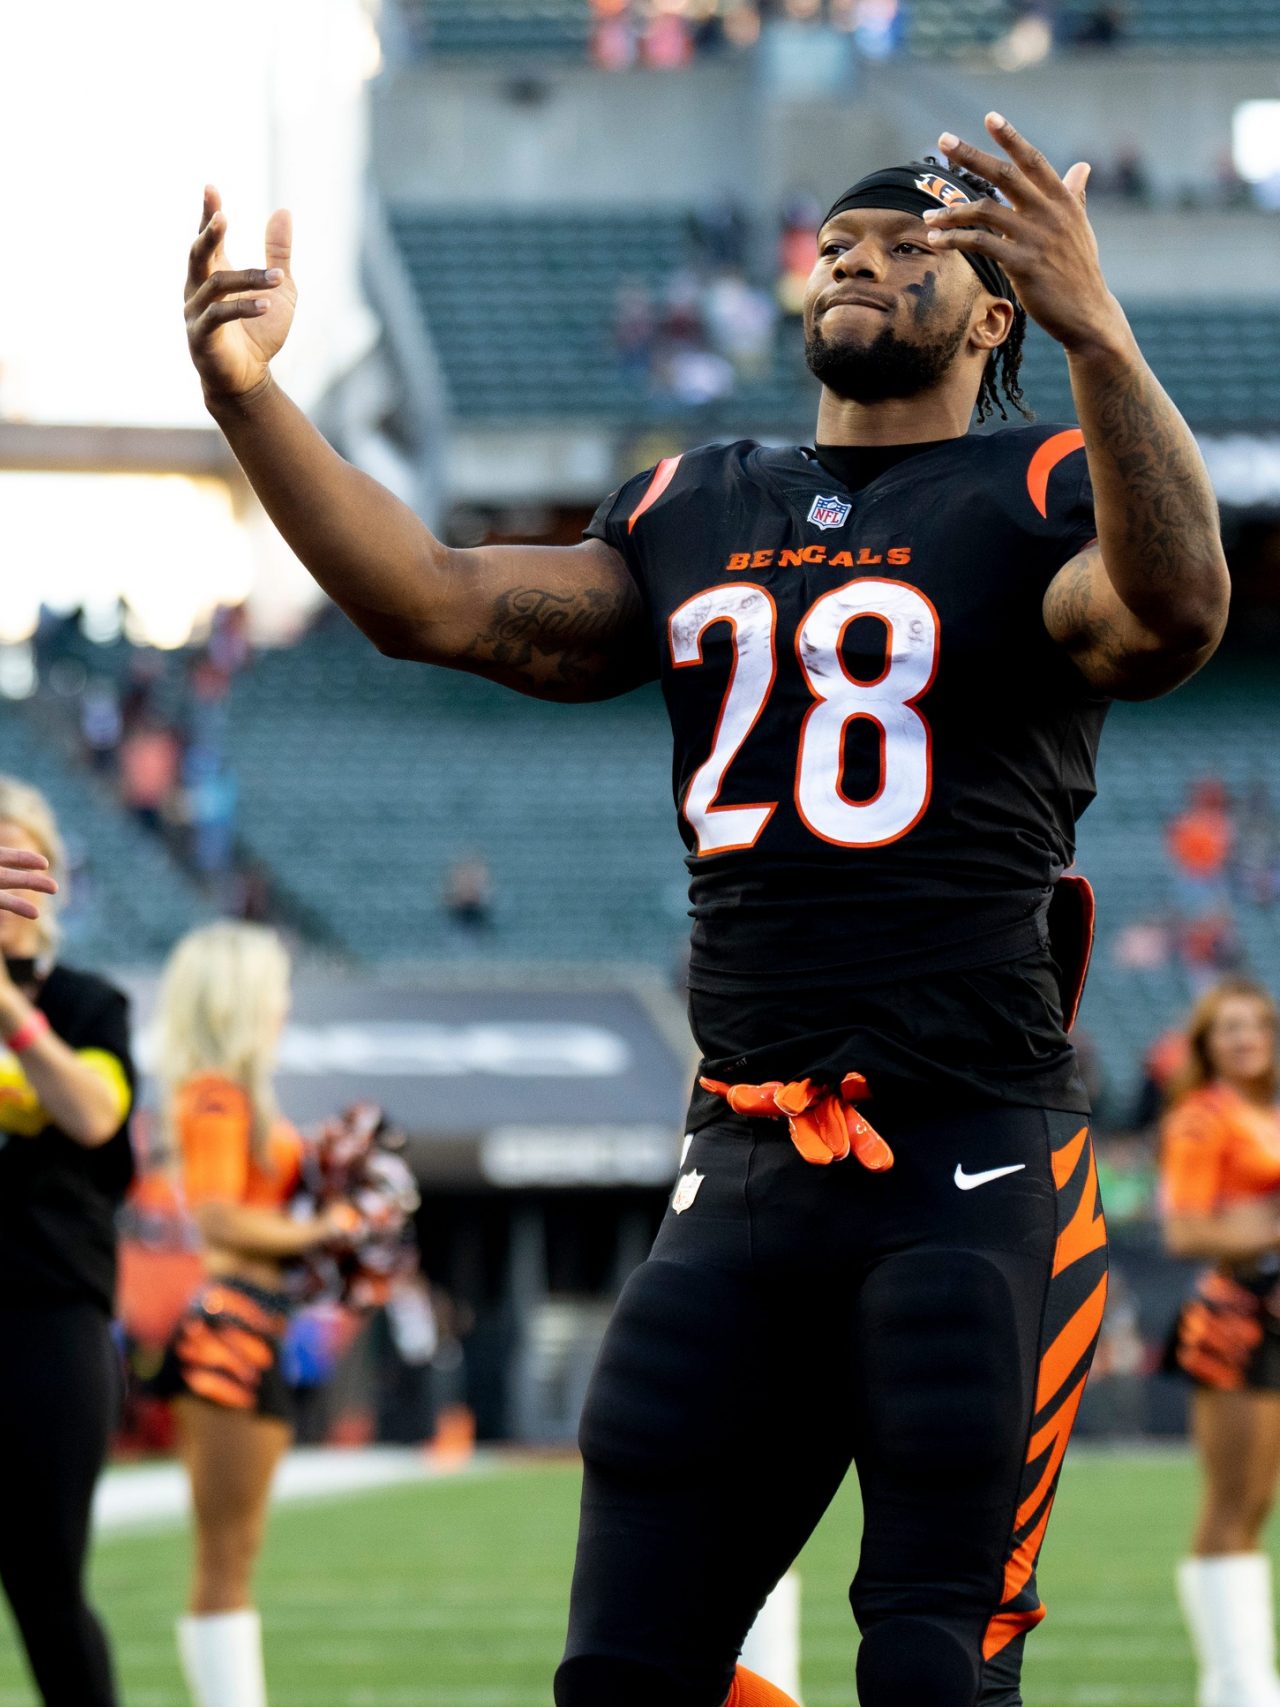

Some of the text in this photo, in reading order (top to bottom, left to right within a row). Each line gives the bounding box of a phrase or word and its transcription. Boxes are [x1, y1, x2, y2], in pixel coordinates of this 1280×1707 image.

[814, 508, 840, 524] NFL
[726, 545, 911, 570] BENGALS
[668, 576, 940, 857] 28
